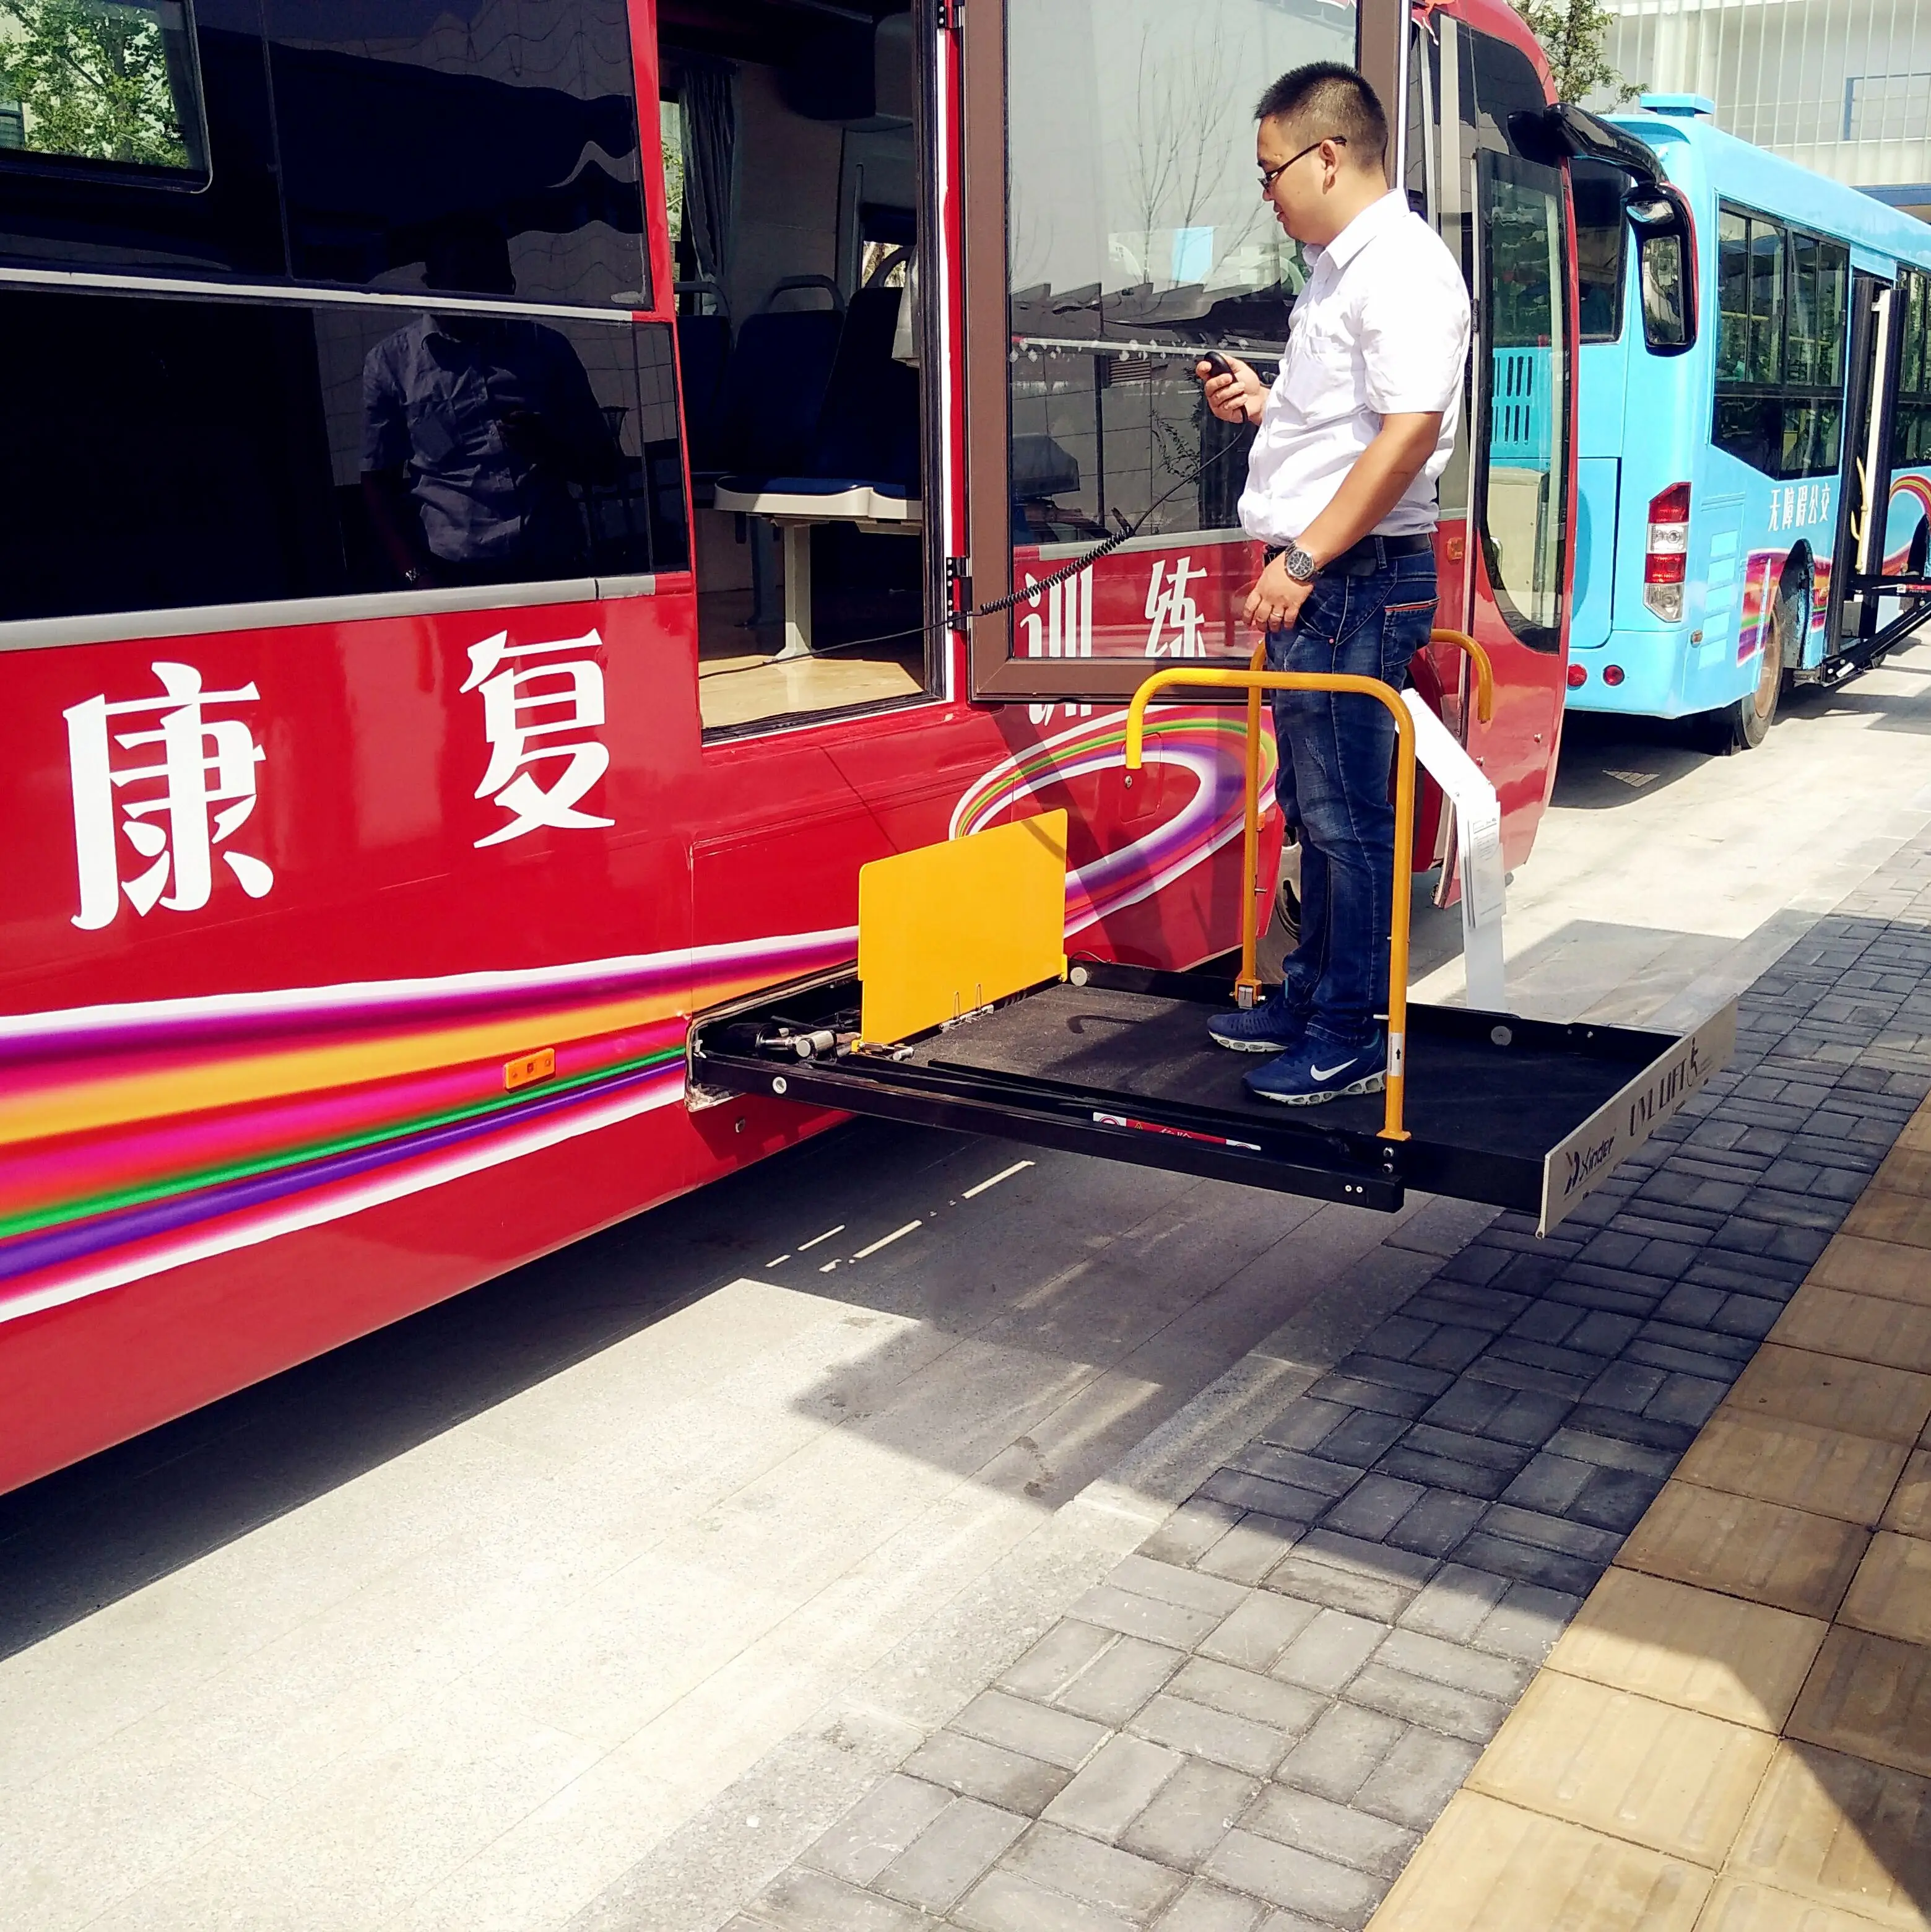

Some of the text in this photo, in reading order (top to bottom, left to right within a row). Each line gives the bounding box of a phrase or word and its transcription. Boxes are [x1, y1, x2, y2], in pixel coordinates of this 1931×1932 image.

[1768, 482, 1831, 532] 无障碍公交
[1659, 1058, 1686, 1110] LIFT
